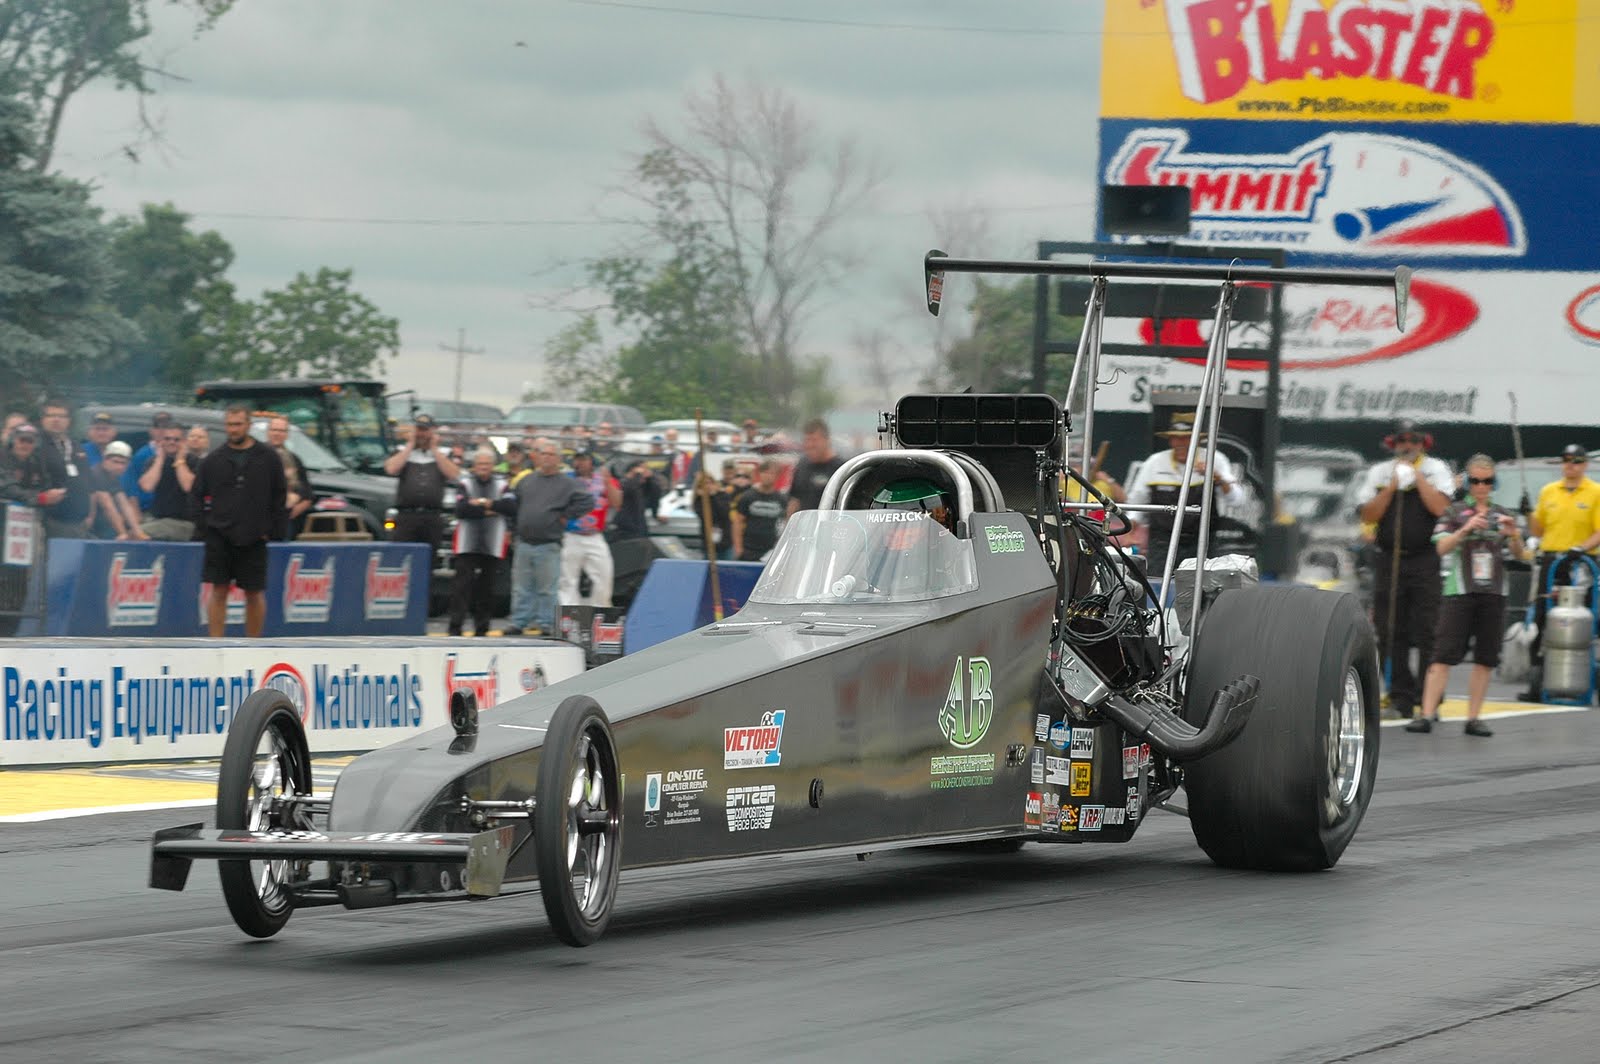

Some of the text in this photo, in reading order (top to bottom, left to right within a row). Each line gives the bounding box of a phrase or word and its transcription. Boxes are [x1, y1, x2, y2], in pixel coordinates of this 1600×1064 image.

[1335, 381, 1479, 417] Equipment
[3, 666, 102, 748] Racing
[312, 664, 423, 730] Nationals
[725, 728, 780, 752] VICTORY
